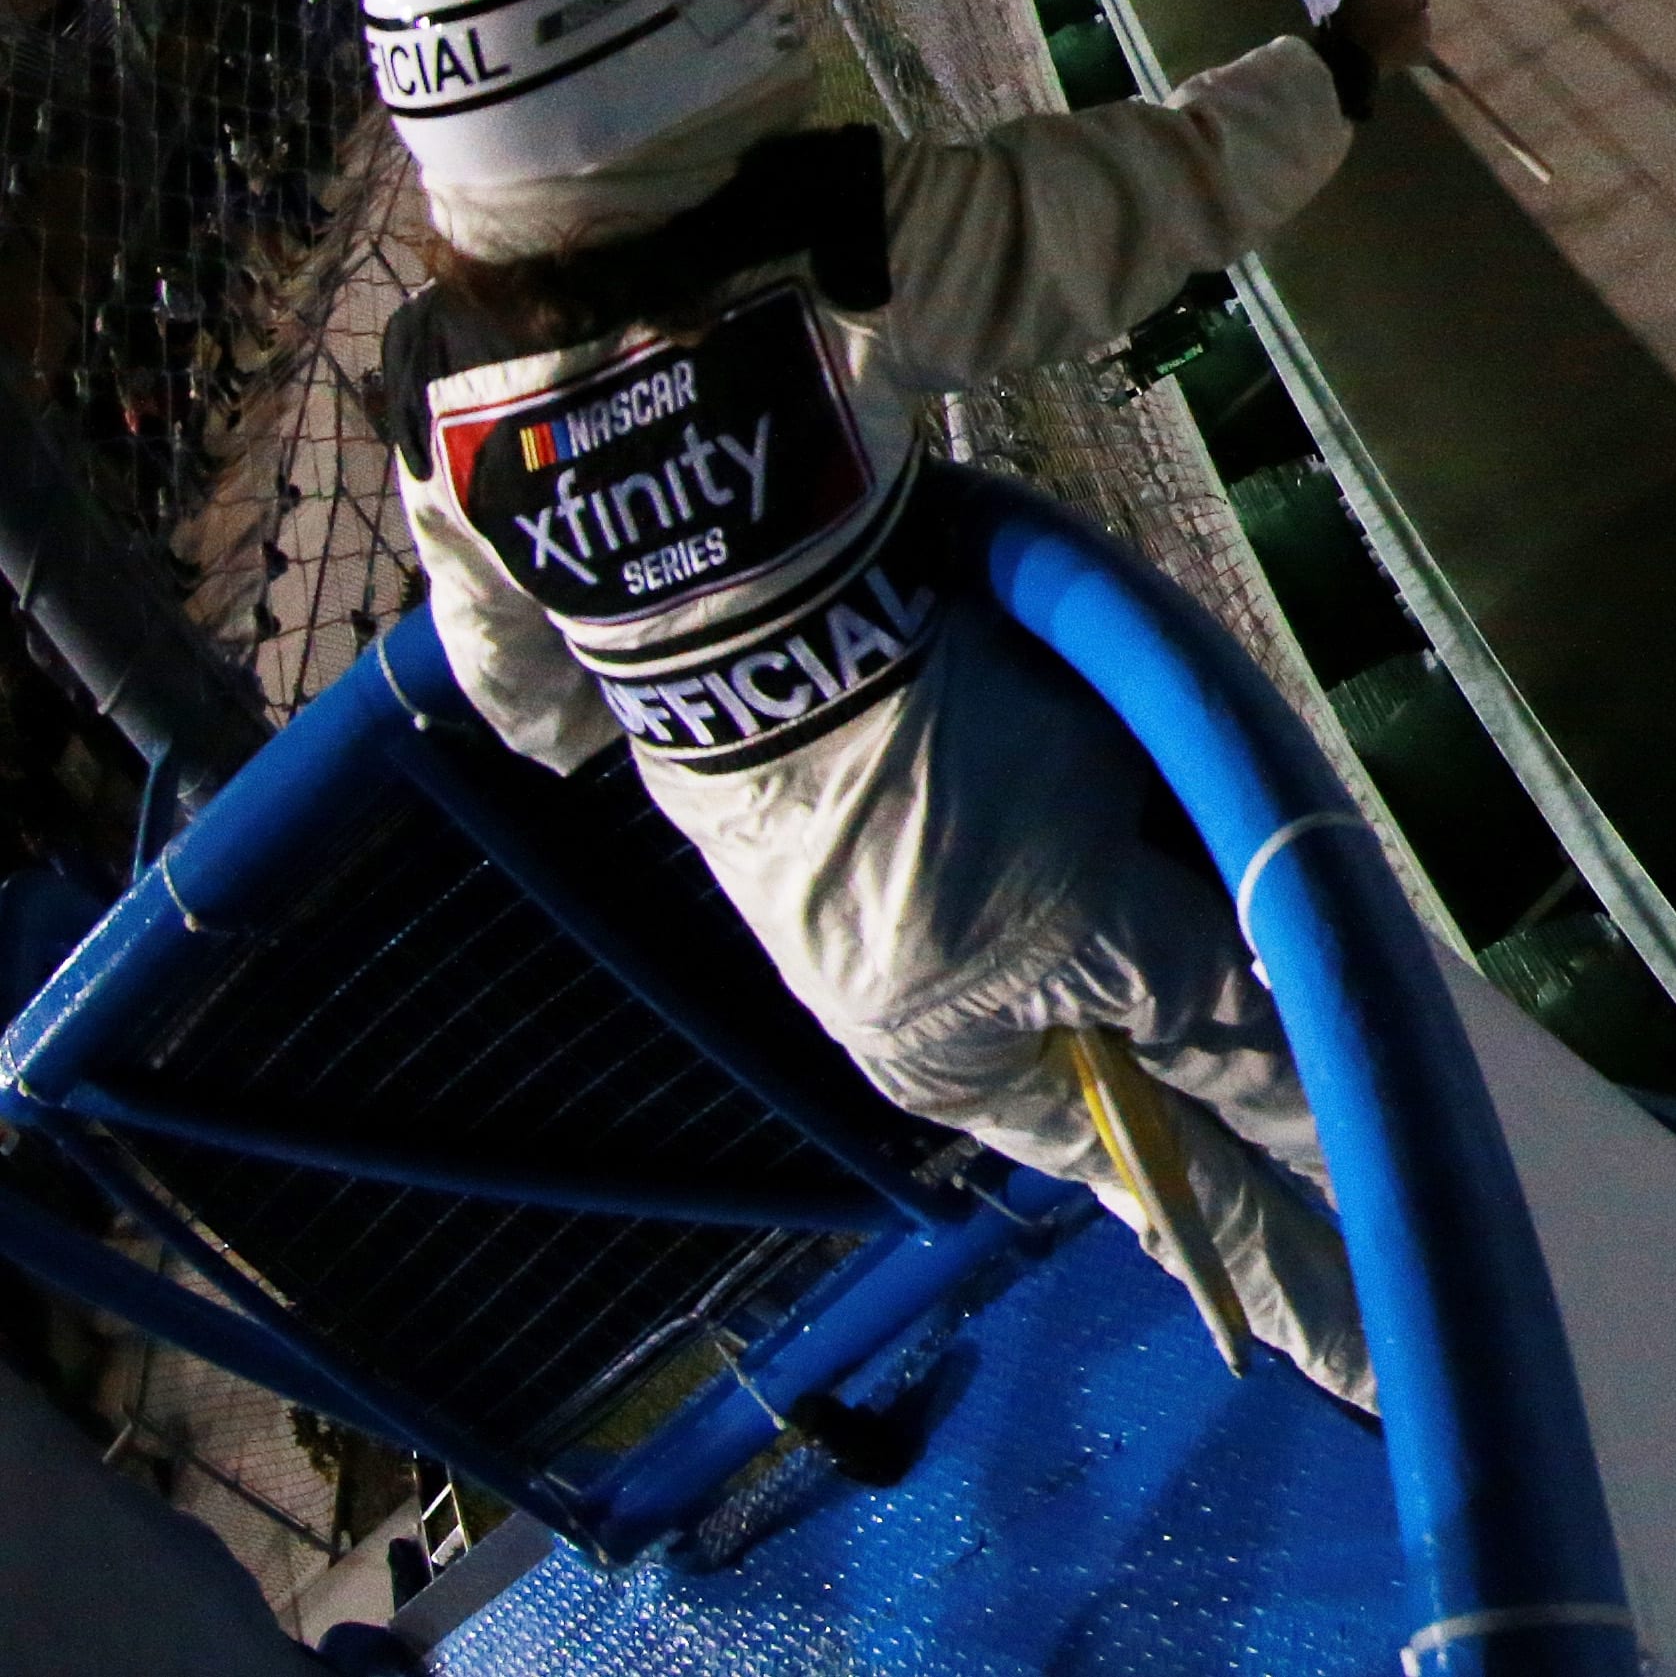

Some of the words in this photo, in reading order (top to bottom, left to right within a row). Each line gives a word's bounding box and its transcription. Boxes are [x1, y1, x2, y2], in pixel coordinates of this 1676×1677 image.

[369, 27, 513, 96] ICIAL
[564, 358, 699, 458] NASCAR
[513, 411, 773, 586] xfinity
[621, 526, 729, 596] SERIES
[600, 565, 938, 747] OFFICIAL
